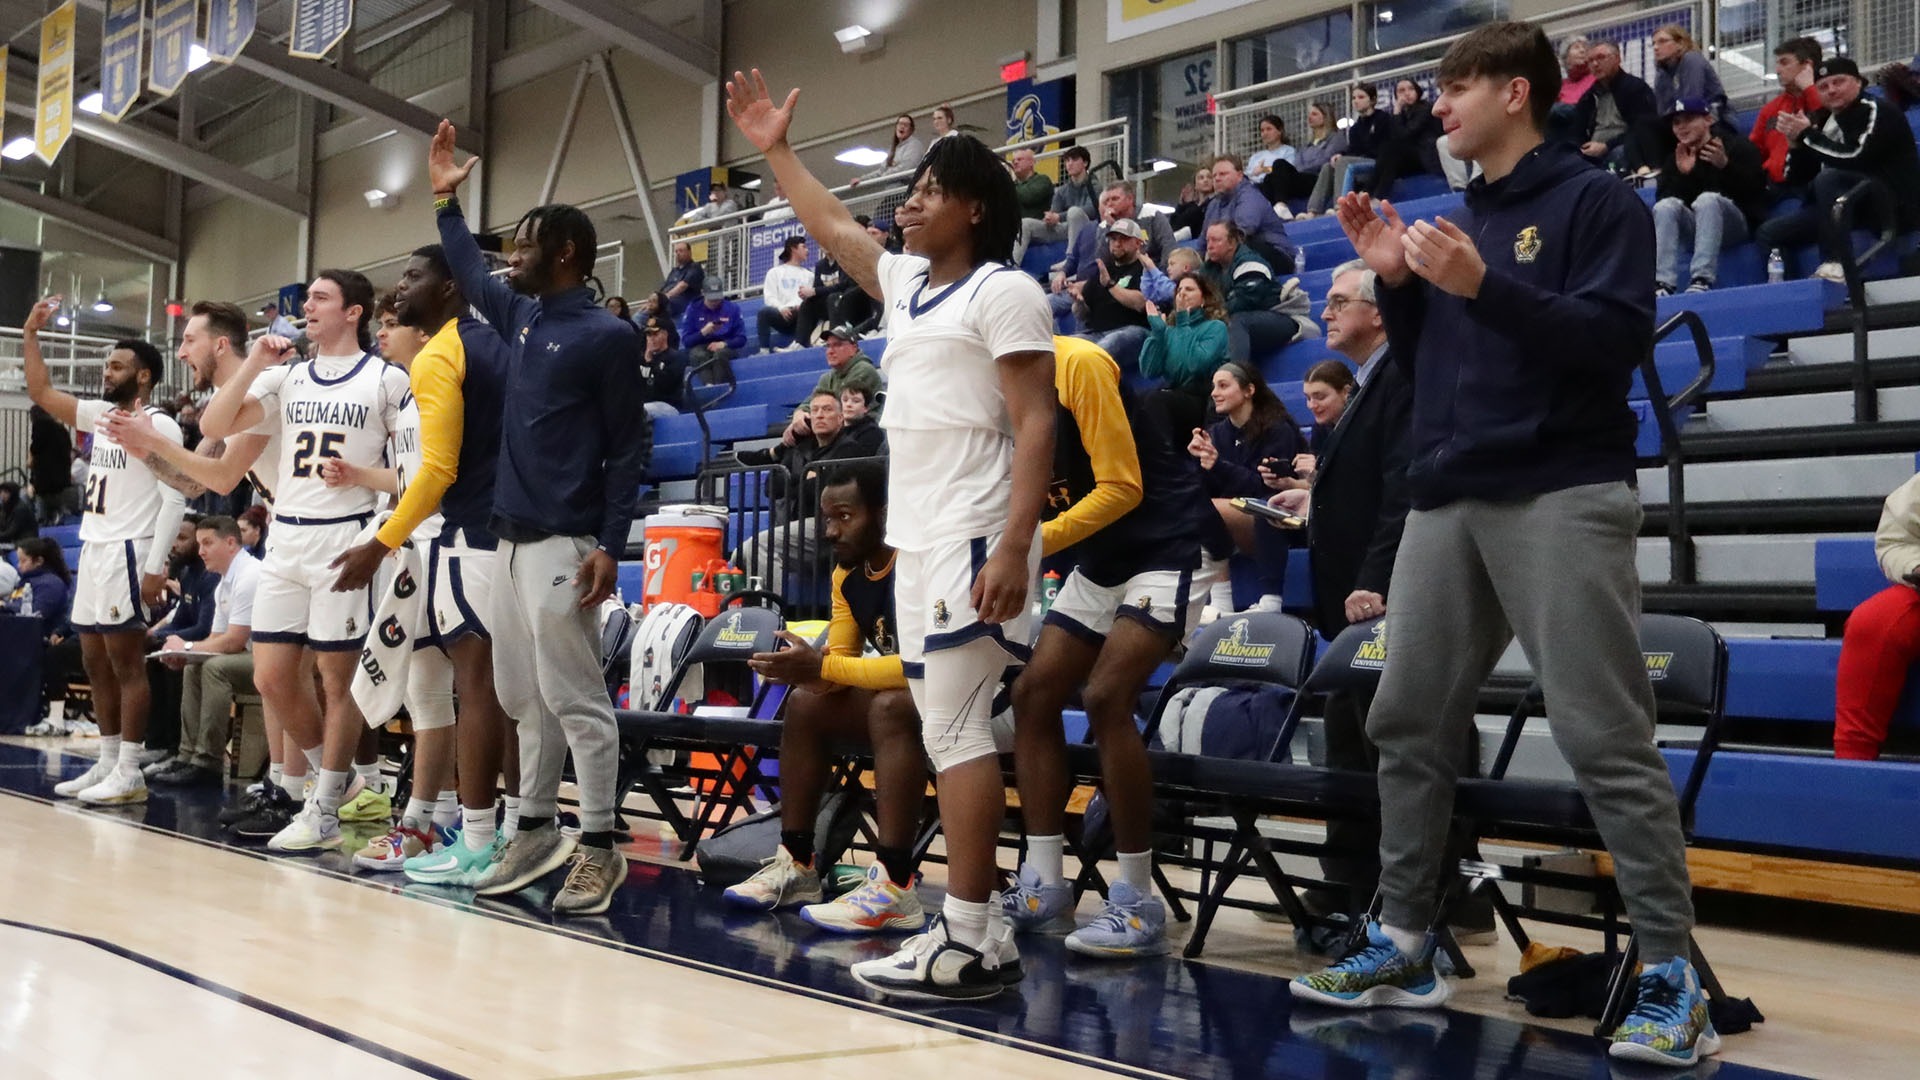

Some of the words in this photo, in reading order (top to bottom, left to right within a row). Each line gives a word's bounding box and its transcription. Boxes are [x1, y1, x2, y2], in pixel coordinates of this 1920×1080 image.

[752, 223, 807, 247] SECTIO
[286, 401, 369, 430] NEUMANN
[293, 431, 346, 480] 25
[84, 473, 108, 515] 21
[646, 542, 661, 570] G
[394, 567, 417, 599] G
[378, 614, 407, 648] G
[1216, 641, 1272, 658] NEUMANN
